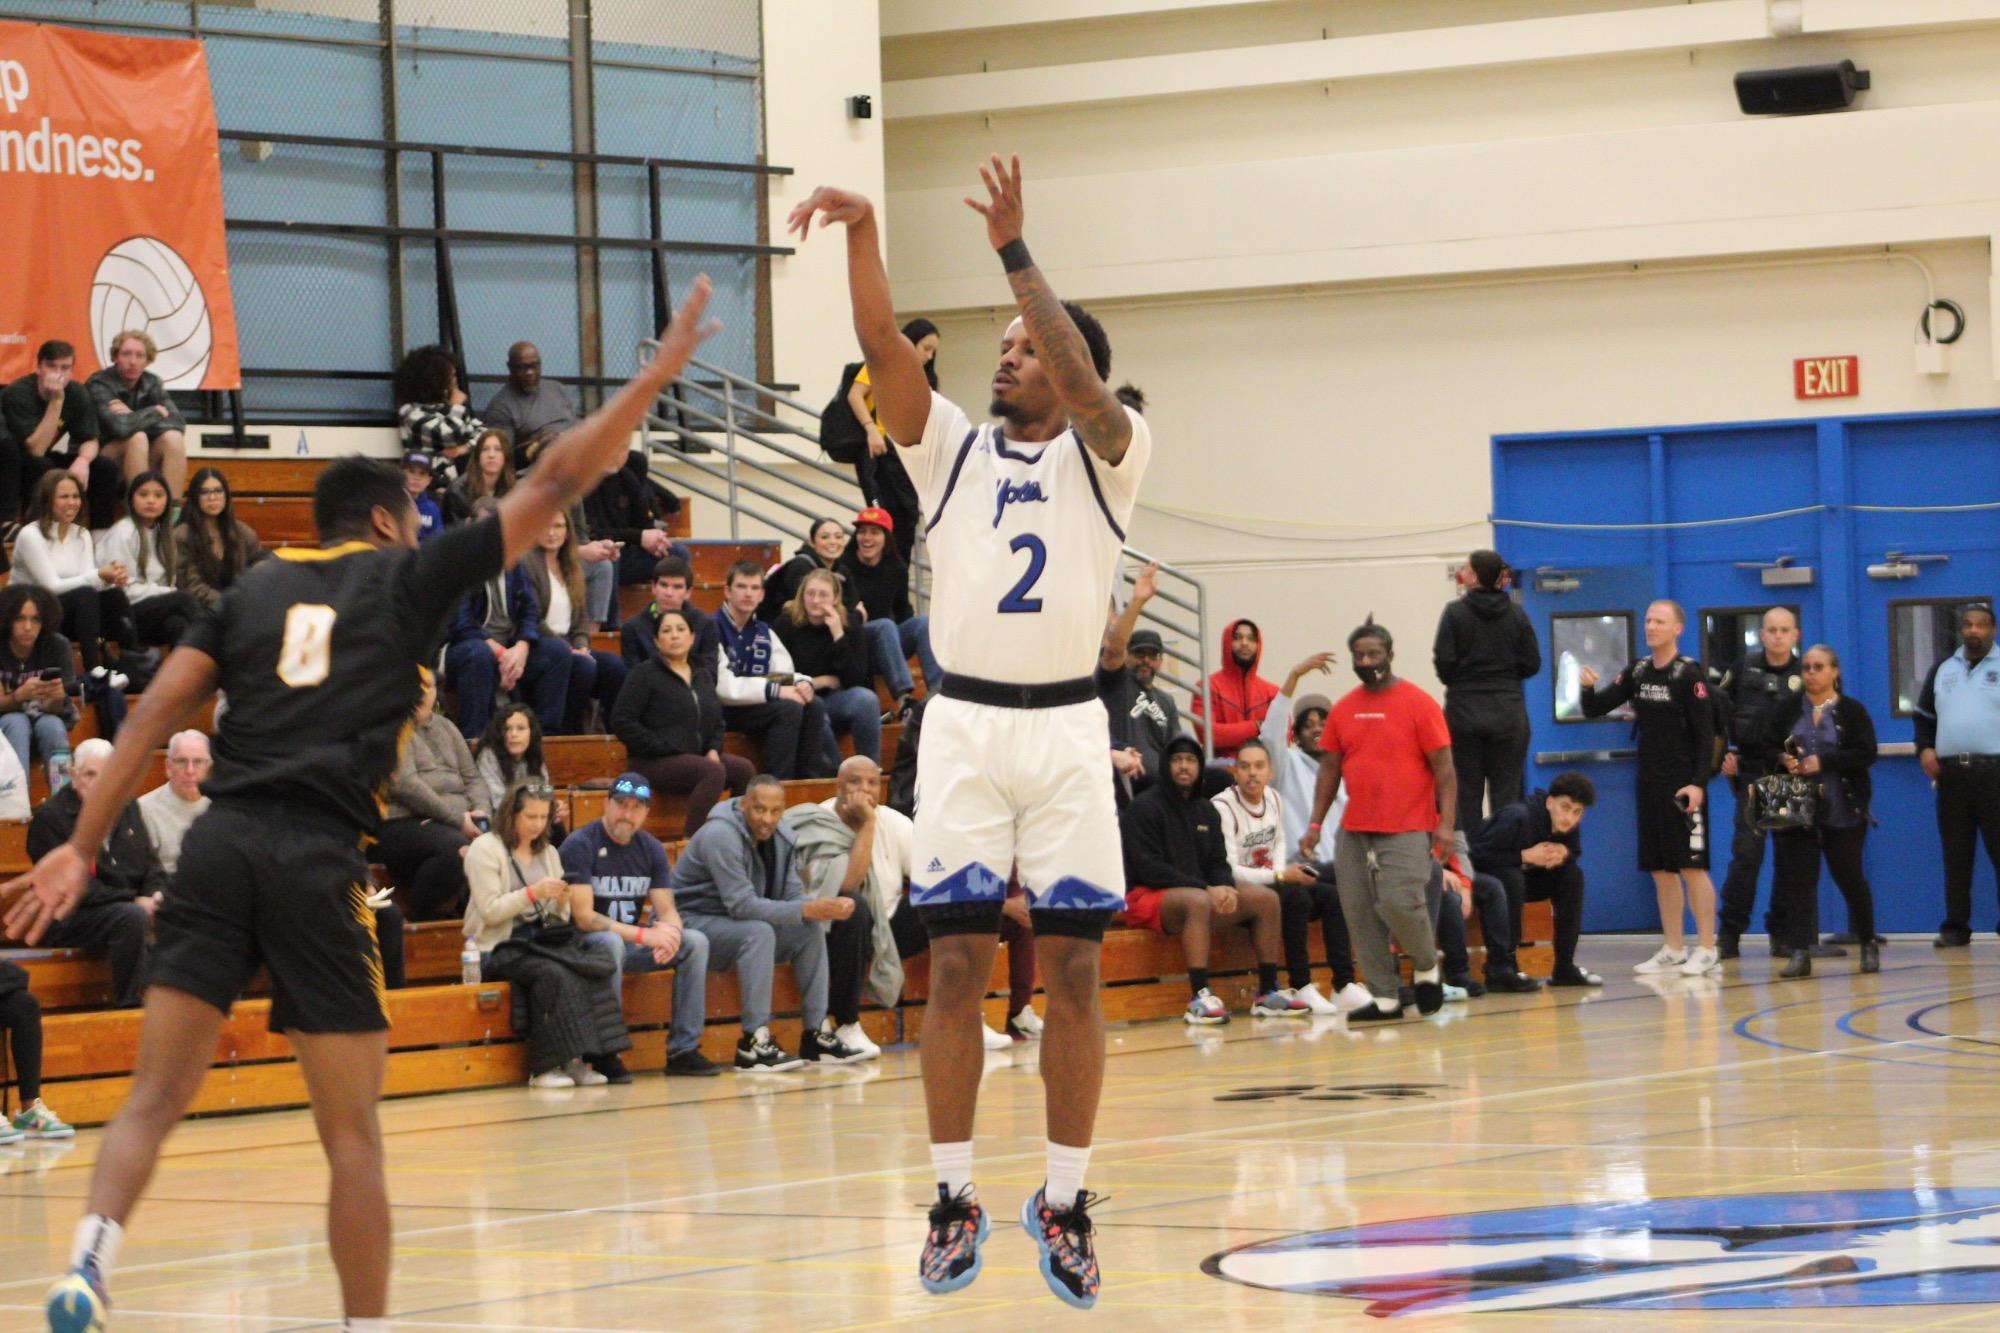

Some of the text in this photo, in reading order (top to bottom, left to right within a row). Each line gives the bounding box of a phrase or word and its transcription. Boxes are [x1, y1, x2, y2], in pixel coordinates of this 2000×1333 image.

[0, 59, 29, 113] p
[1804, 359, 1848, 394] EXIT
[296, 429, 310, 455] A
[997, 533, 1047, 613] 2
